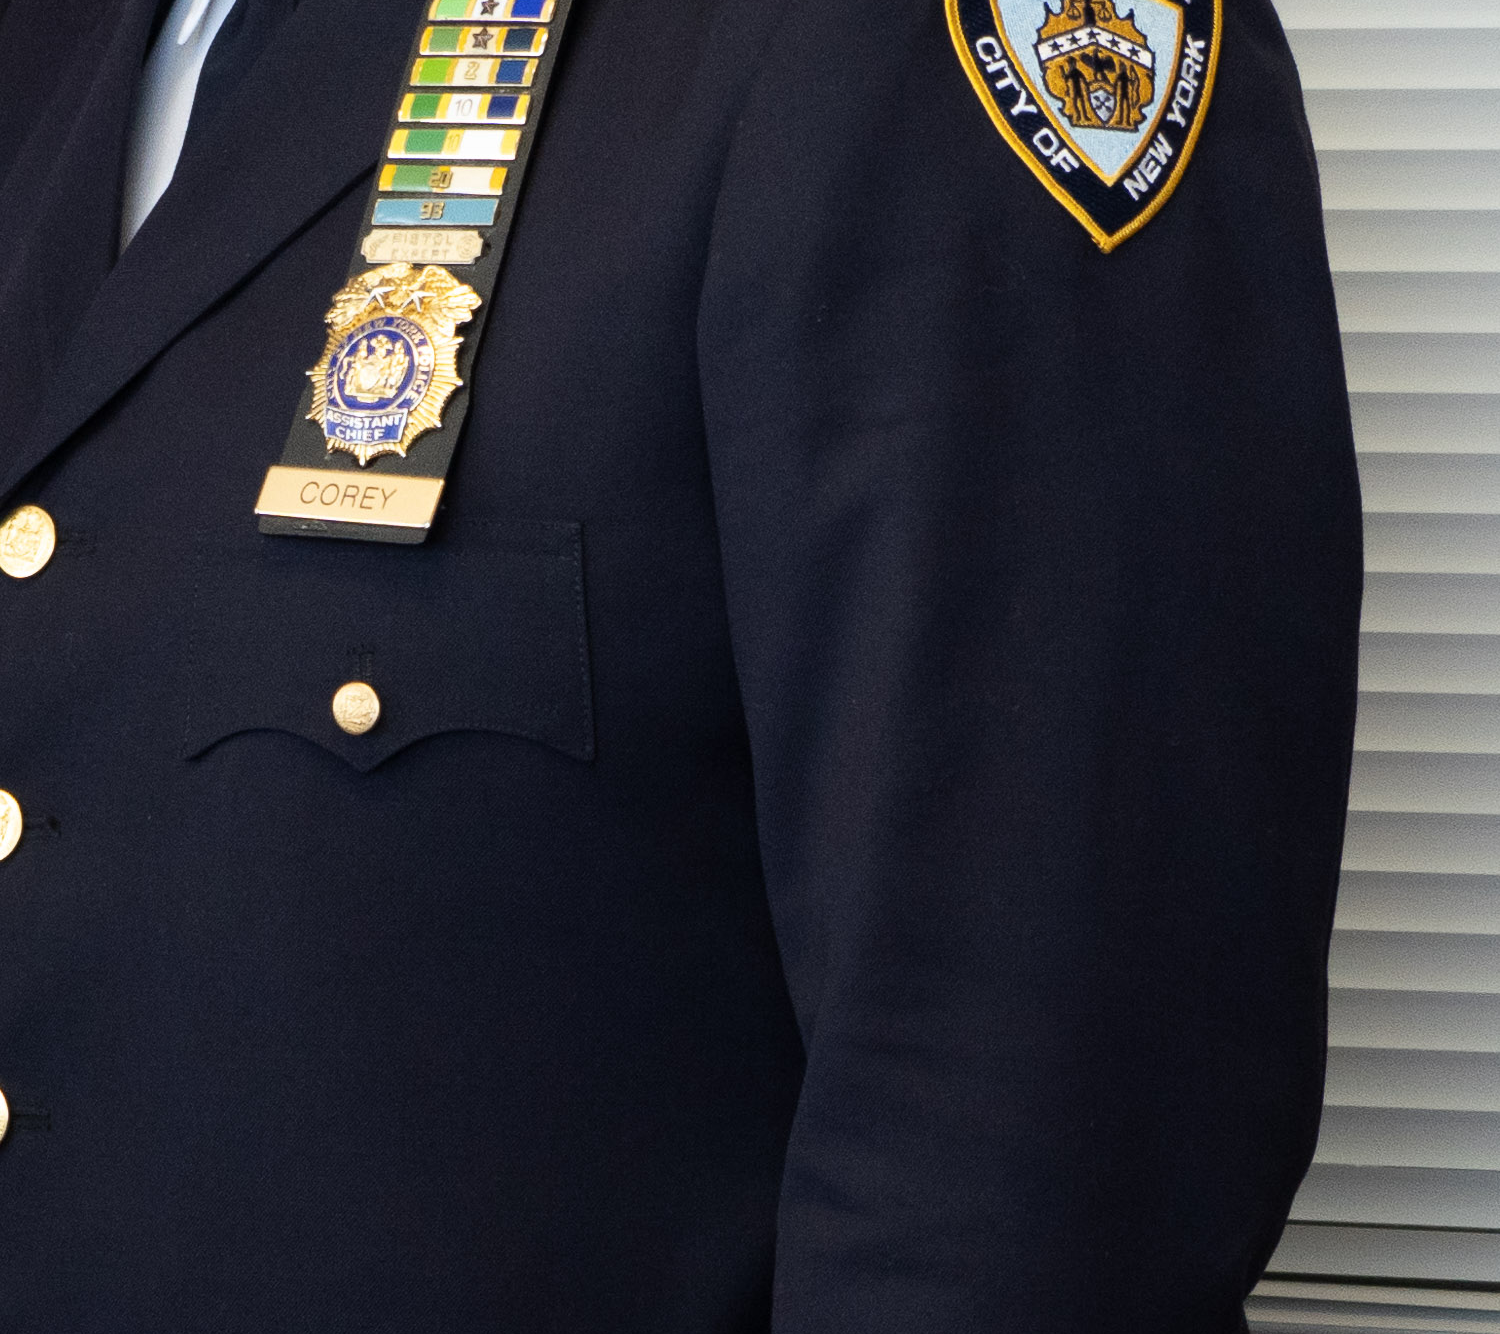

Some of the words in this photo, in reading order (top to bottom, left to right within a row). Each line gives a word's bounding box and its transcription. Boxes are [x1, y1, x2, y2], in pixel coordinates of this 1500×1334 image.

[464, 61, 480, 81] 2
[455, 98, 474, 117] 10
[975, 35, 1038, 118] CITY
[1032, 126, 1080, 173] OF
[1123, 131, 1174, 201] NEW
[1167, 33, 1206, 128] YORK
[429, 169, 454, 189] 20
[394, 317, 426, 344] YORK
[406, 345, 433, 404] POLICE
[327, 411, 403, 429] ASSISTANT
[335, 427, 386, 442] CHIEF
[300, 481, 397, 510] COREY
